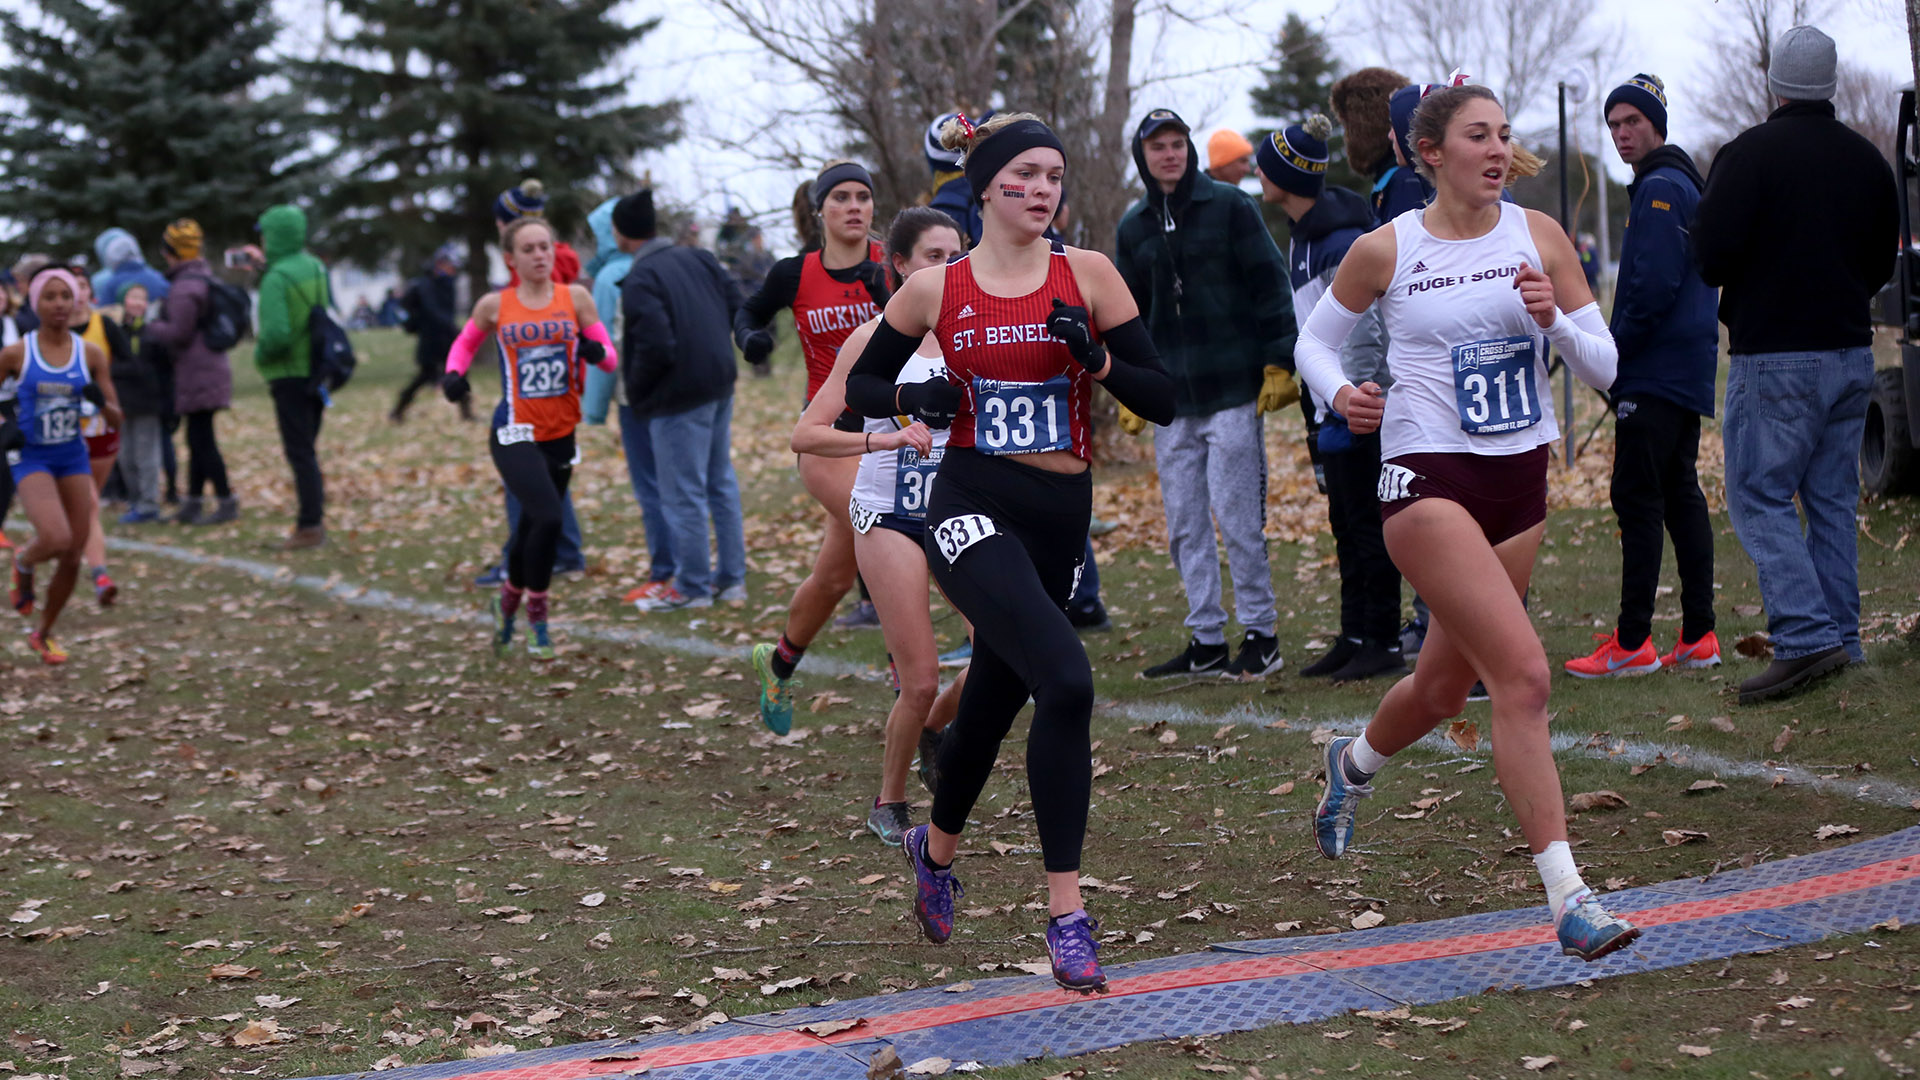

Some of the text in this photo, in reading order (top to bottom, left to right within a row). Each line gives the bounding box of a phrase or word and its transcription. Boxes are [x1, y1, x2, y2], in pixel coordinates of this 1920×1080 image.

[1408, 276, 1467, 296] PUGET
[502, 321, 576, 345] HOPE
[953, 329, 981, 351] ST.
[986, 324, 1067, 345] BENED
[1480, 345, 1504, 356] CROSS
[1504, 341, 1531, 353] COUNTRY
[520, 360, 566, 392] 232
[1463, 367, 1532, 423] 311
[42, 409, 78, 440] 132
[985, 395, 1058, 448] 331
[1478, 422, 1509, 432] NOVEMBER
[1379, 467, 1406, 499] 311
[939, 516, 986, 557] 331
